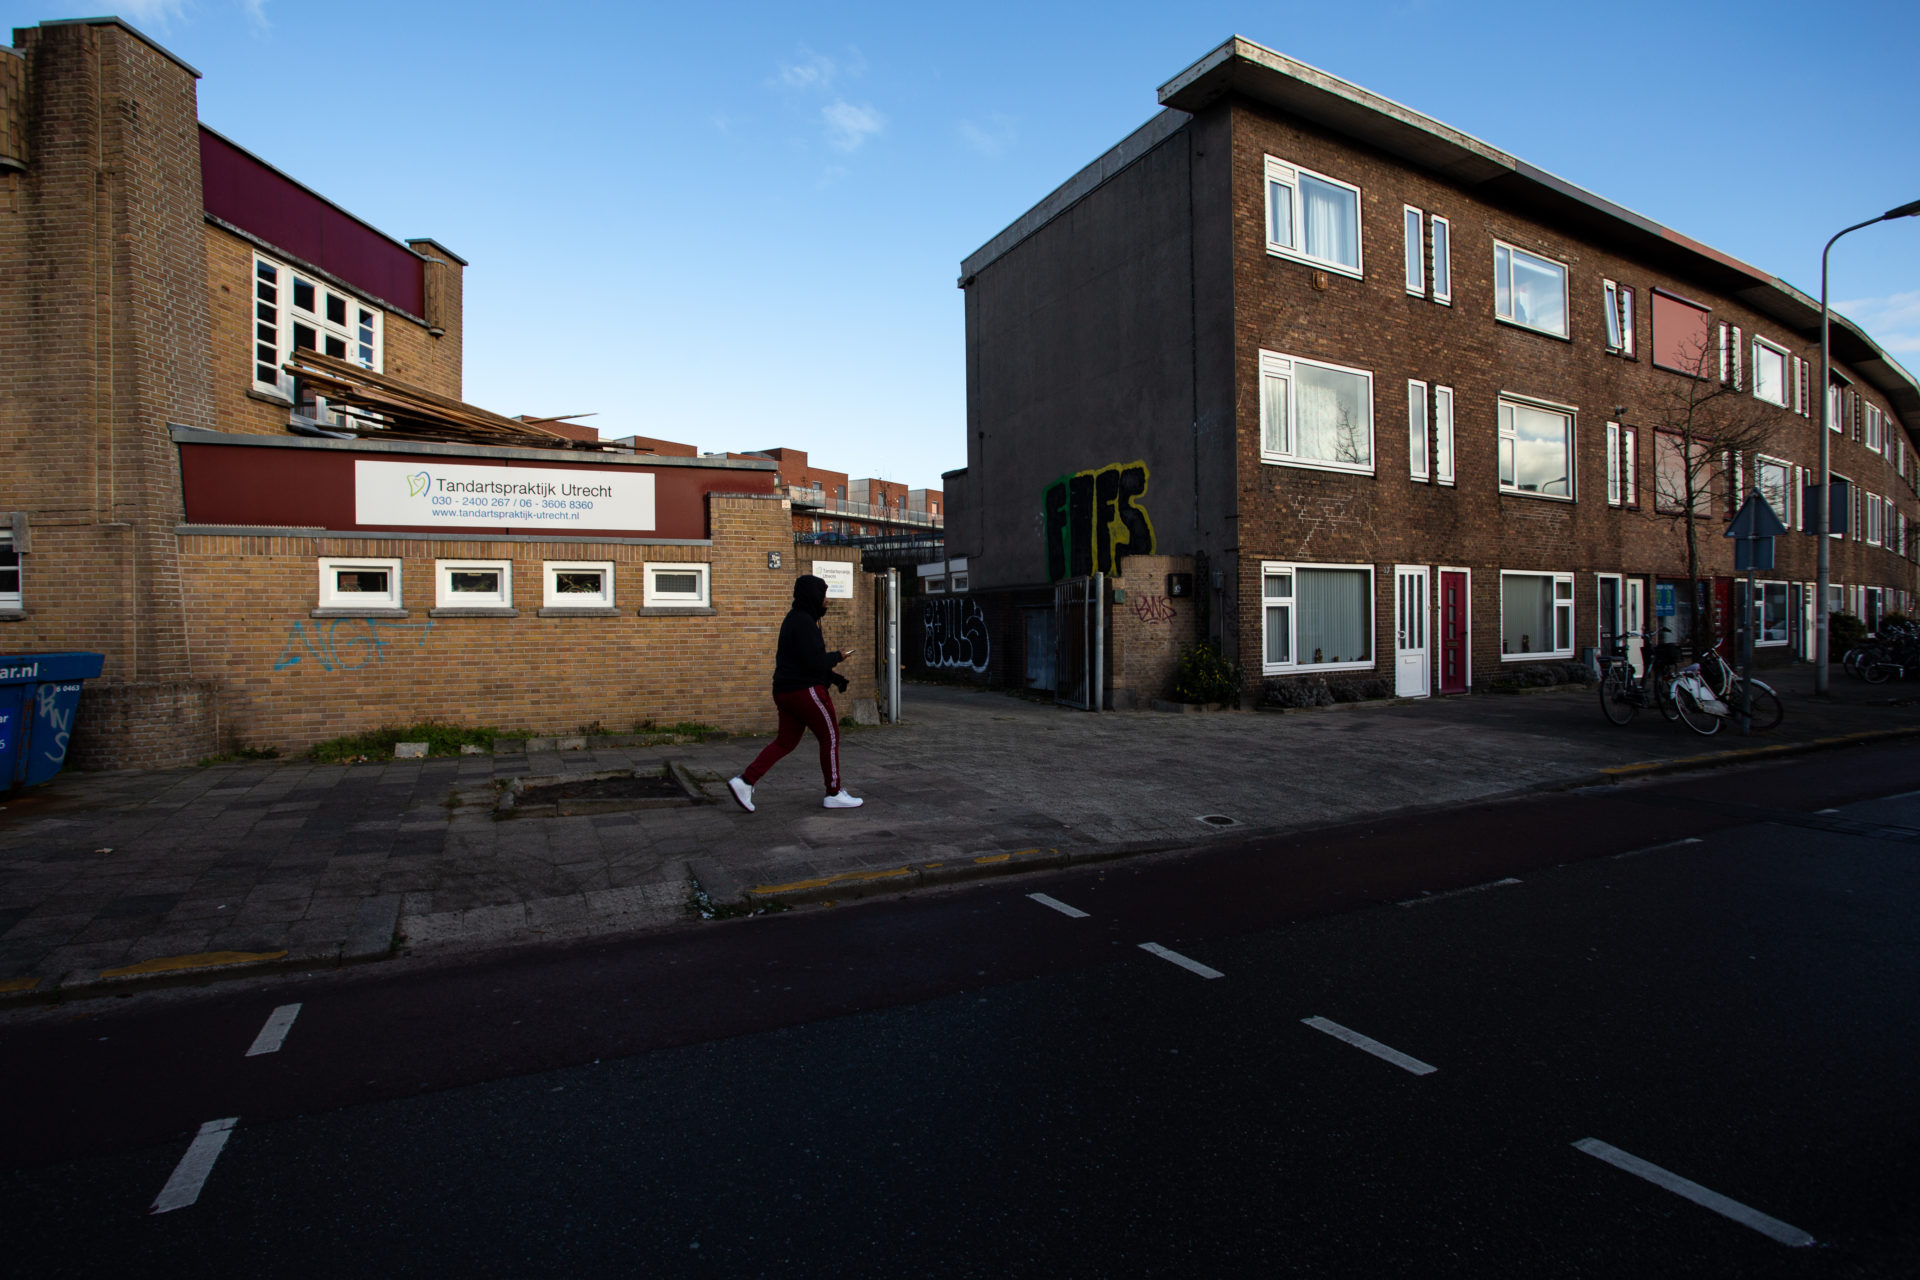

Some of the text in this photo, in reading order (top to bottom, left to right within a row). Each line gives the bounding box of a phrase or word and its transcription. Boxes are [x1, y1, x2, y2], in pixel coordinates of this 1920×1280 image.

[436, 478, 612, 498] Tandartspraktijk Utrecht
[431, 496, 452, 505] 030
[462, 497, 488, 506] 2400
[491, 498, 510, 507] 267
[519, 498, 532, 508] 06
[541, 499, 567, 509] 3606
[569, 500, 594, 509] 8360
[432, 509, 580, 520] www.tandartspraktijk-utrecht.nl
